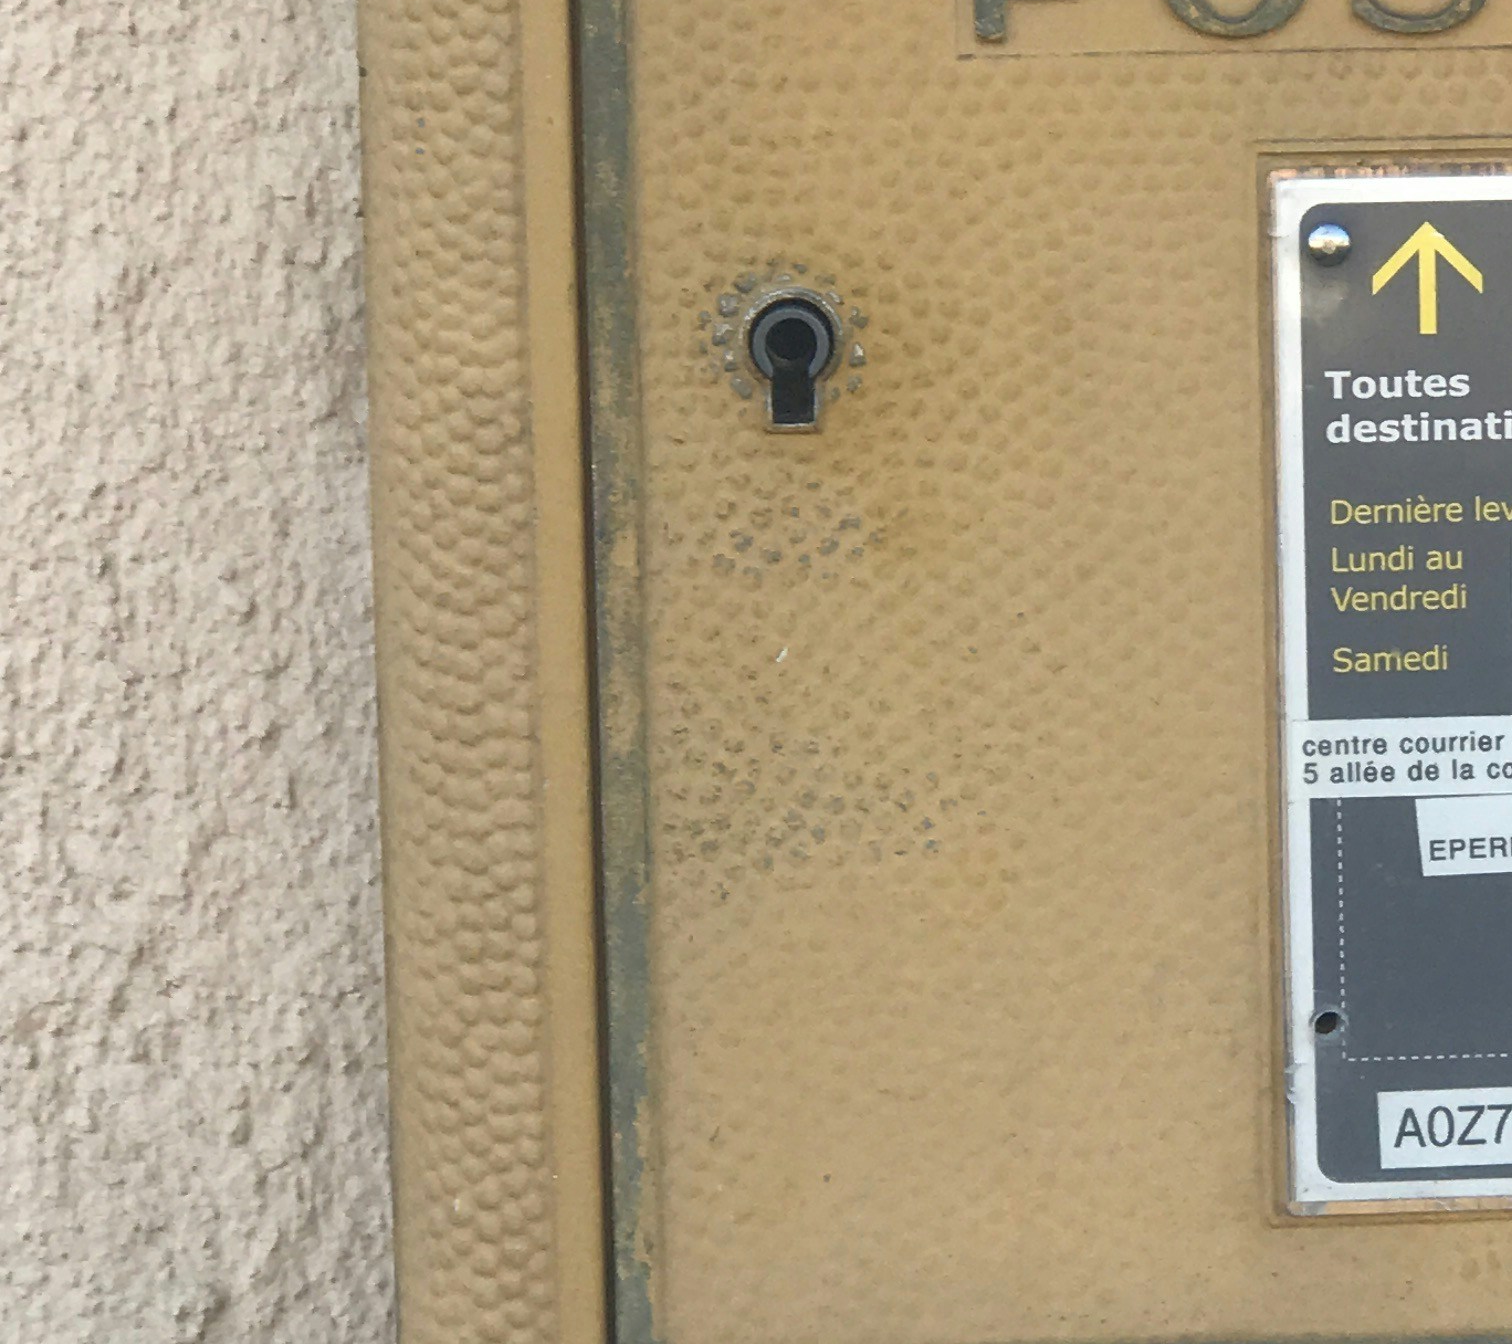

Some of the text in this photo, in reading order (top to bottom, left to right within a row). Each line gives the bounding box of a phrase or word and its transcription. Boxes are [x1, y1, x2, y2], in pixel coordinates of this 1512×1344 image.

[1324, 369, 1471, 400] Toutes
[1331, 495, 1464, 525] Dernière
[1331, 546, 1463, 574] Lundi au
[1331, 584, 1467, 613] Vendredi
[1332, 645, 1449, 674] Samedi
[1302, 735, 1388, 757] centre
[1399, 729, 1504, 755] courrier
[1303, 763, 1319, 784] 5
[1329, 759, 1395, 784] allée
[1407, 758, 1440, 781] de
[1451, 757, 1476, 780] la
